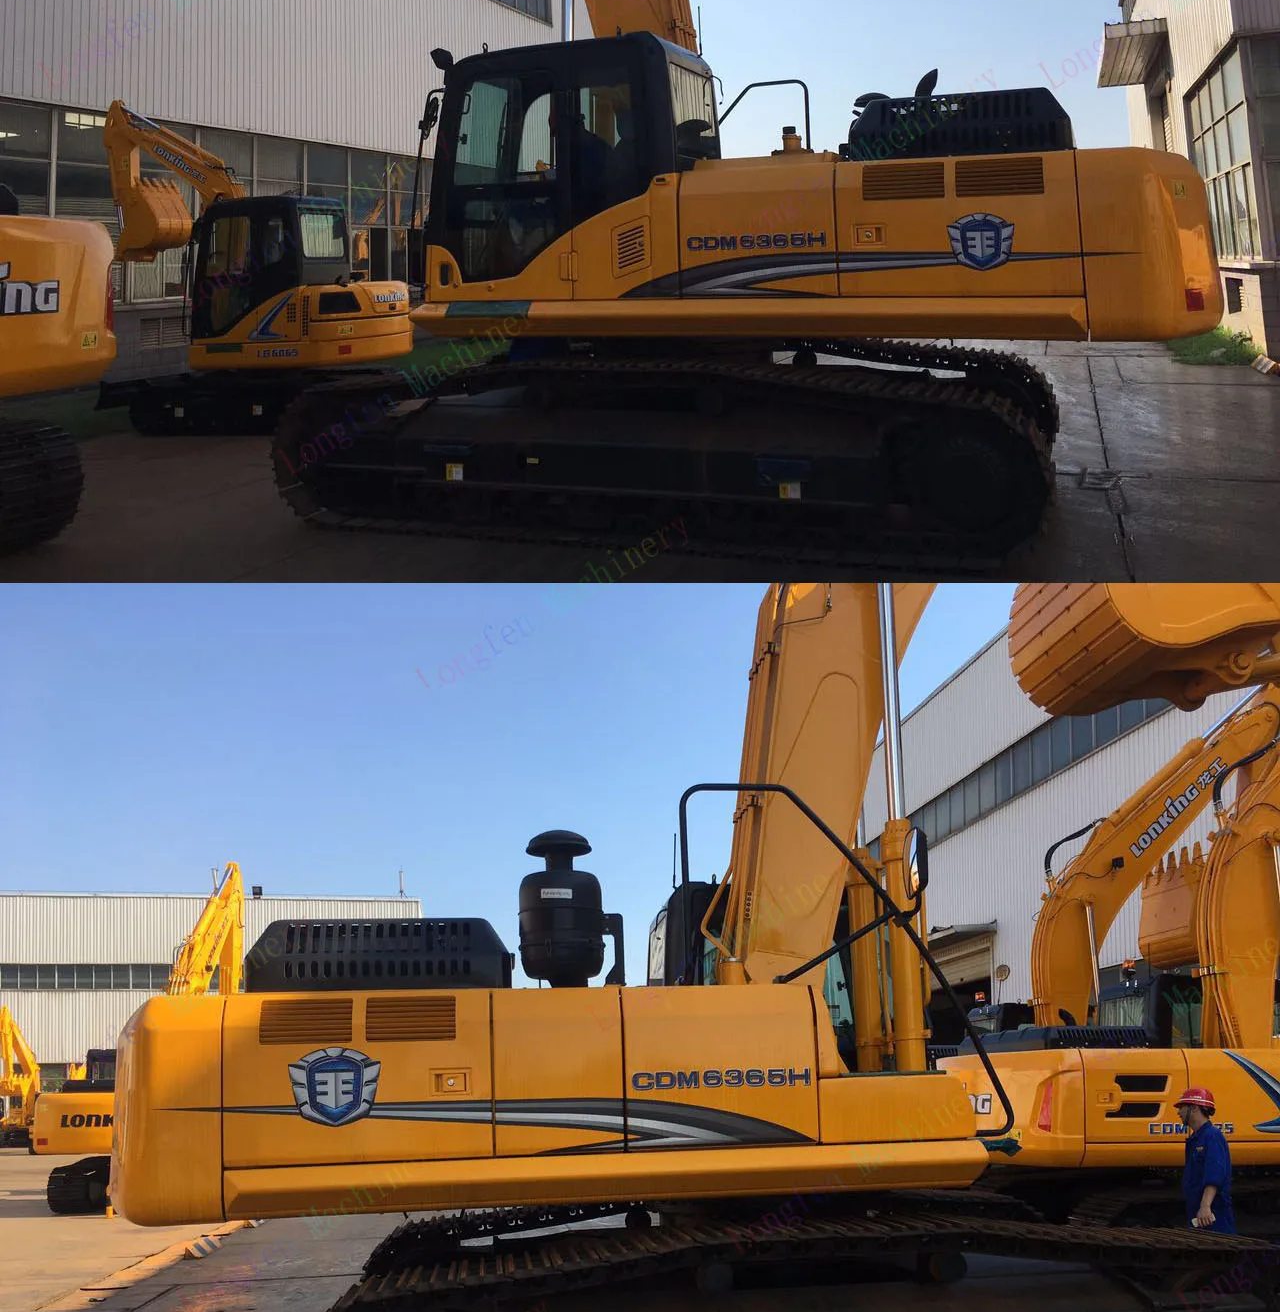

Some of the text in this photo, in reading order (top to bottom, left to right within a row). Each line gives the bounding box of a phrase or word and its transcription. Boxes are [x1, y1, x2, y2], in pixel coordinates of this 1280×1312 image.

[687, 232, 826, 251] CDM6365H
[1196, 757, 1227, 791] 龙工
[632, 1068, 812, 1091] CDM6365H
